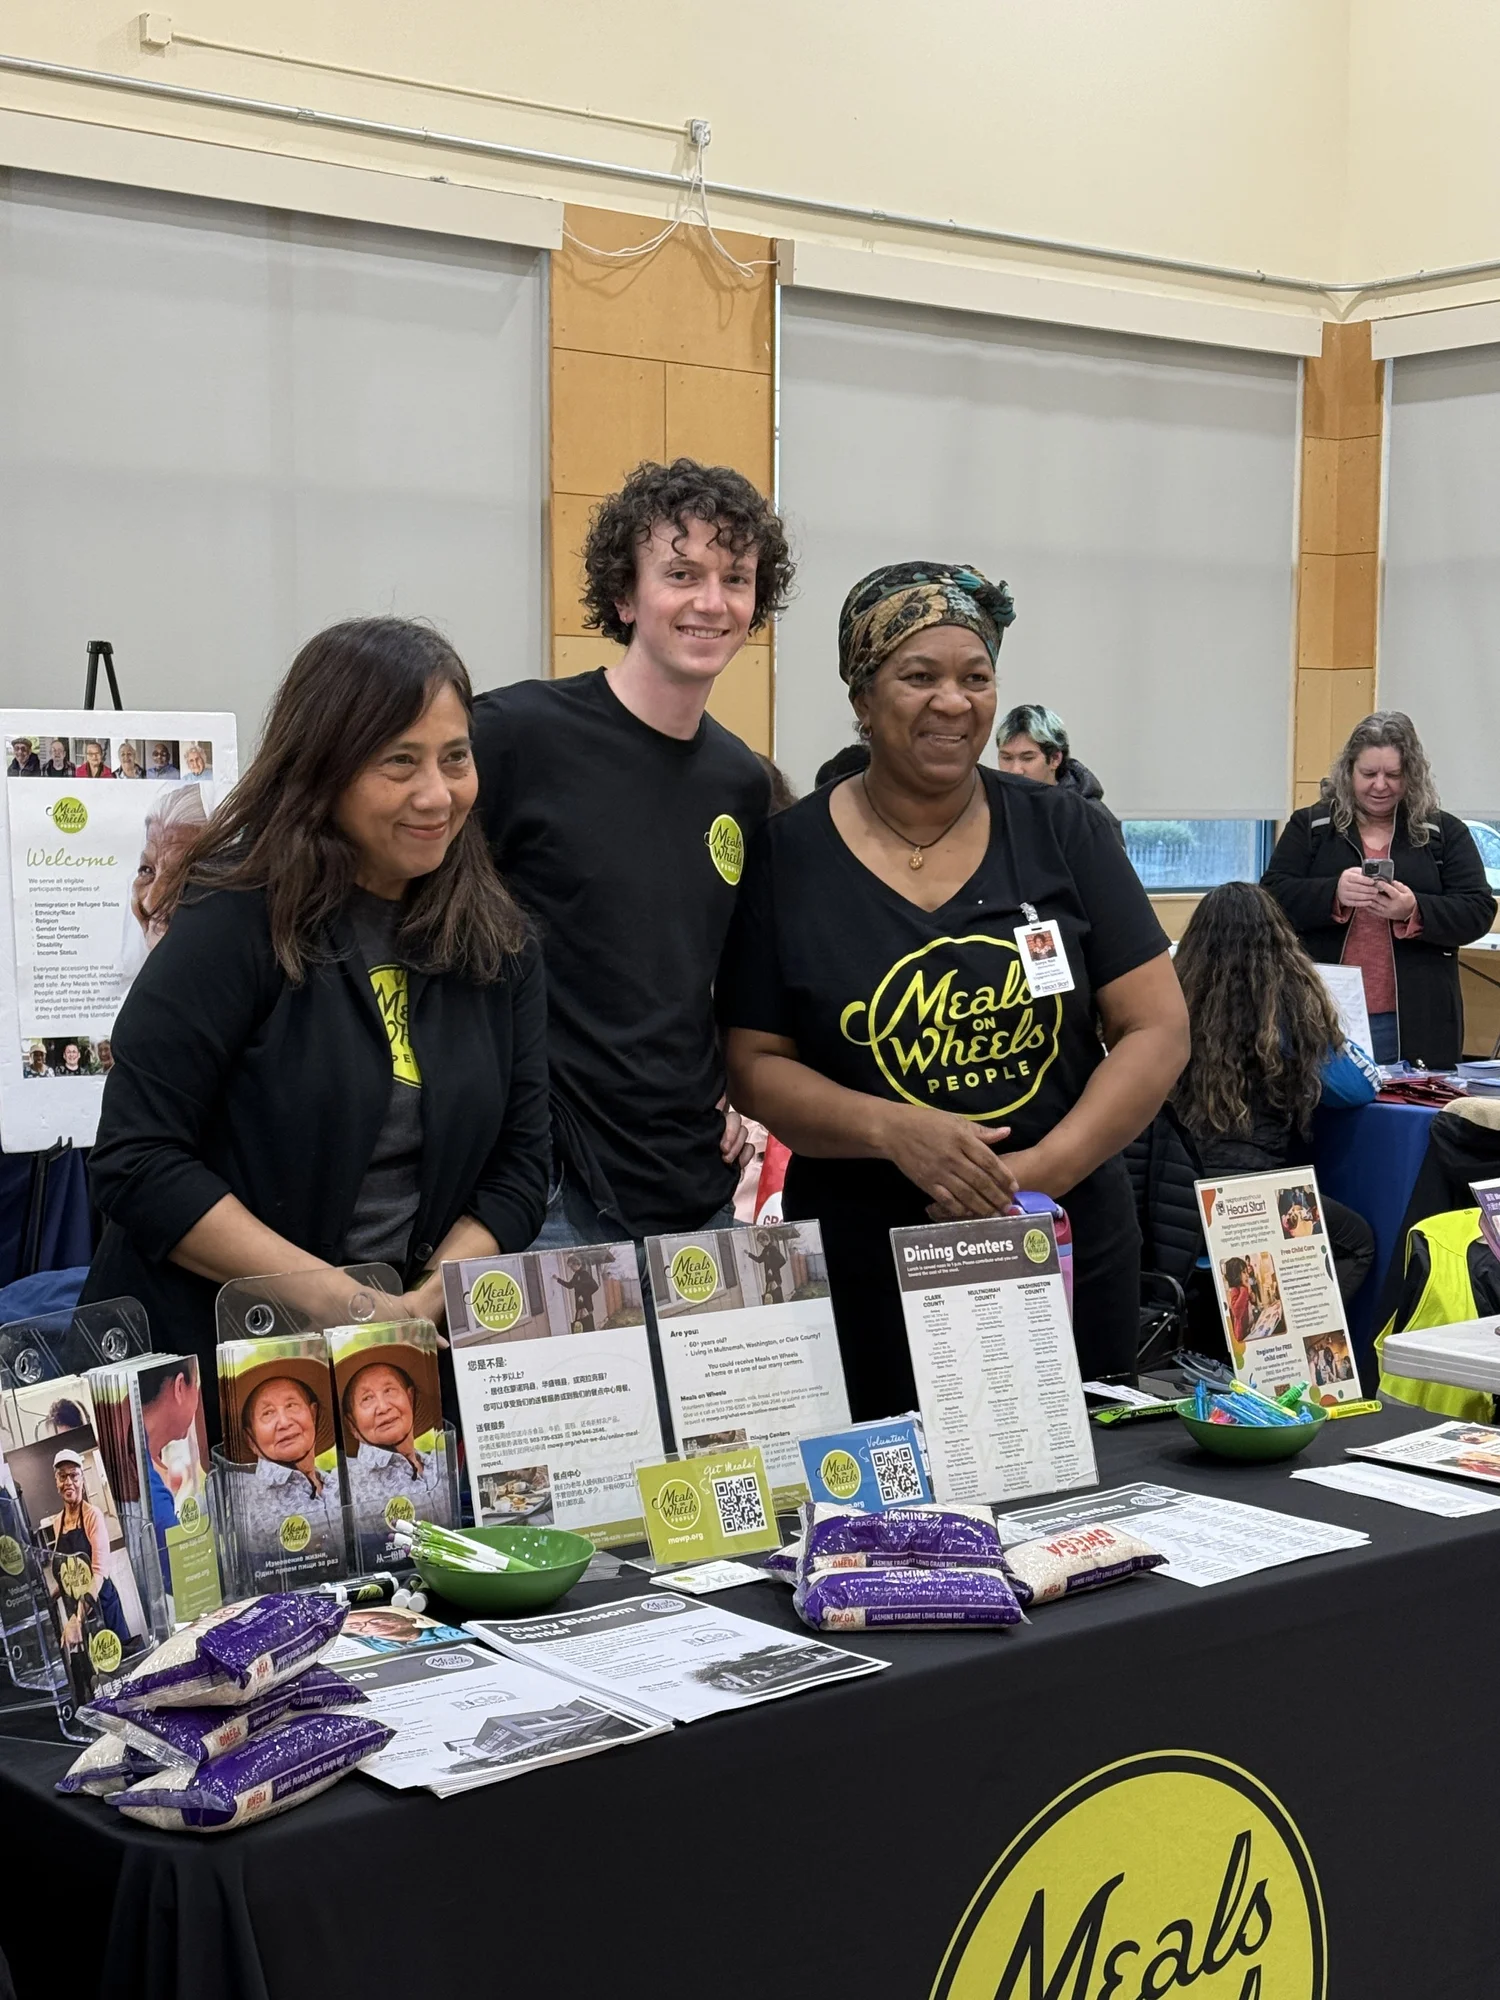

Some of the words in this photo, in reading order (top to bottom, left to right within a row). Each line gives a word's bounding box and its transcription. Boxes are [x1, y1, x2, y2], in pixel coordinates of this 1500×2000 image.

[46, 802, 84, 816] Meals
[27, 848, 117, 867] Welcome
[973, 1017, 995, 1031] ON
[888, 1007, 1044, 1075] Wheels
[928, 1060, 1030, 1093] PEOPLE
[1226, 1202, 1248, 1215] Head
[1248, 1199, 1266, 1212] Start
[903, 1244, 954, 1263] Dining
[956, 1239, 1013, 1258] Centers
[664, 1256, 710, 1278] Meals
[675, 1270, 713, 1287] Wheels
[1016, 1281, 1050, 1289] WASHINGTON
[463, 1281, 515, 1305] Meals
[684, 1286, 710, 1294] PEOPLE
[967, 1286, 1000, 1295] MULTNOMAH
[974, 1293, 995, 1301] COUNTY
[1024, 1287, 1045, 1295] COUNTY
[476, 1299, 518, 1316] Wheels
[922, 1299, 944, 1307] COUNTY
[485, 1313, 514, 1322] PEOPLE
[670, 1329, 682, 1337] Are
[683, 1328, 699, 1337] you:
[690, 1349, 706, 1357] Living
[713, 1344, 745, 1352] Multnomah,
[745, 1339, 778, 1348] Washington,
[785, 1335, 798, 1343] Clark
[800, 1332, 820, 1341] County?
[1256, 1347, 1274, 1356] Register
[1282, 1342, 1292, 1350] FREE
[778, 1351, 798, 1359] Wheels
[783, 1358, 804, 1366] centers.
[1264, 1354, 1275, 1362] child
[467, 1355, 507, 1371] 您是不是:
[706, 1389, 726, 1398] Wheels
[769, 1430, 790, 1438] Centers
[867, 1429, 910, 1447] Volunteer!
[480, 1460, 503, 1468] request.
[704, 1464, 724, 1480] Get
[724, 1456, 757, 1472] Meals!
[815, 1457, 854, 1480] Meals
[826, 1470, 858, 1487] Wheels
[652, 1487, 694, 1510] Meals
[663, 1500, 697, 1518] Wheels
[882, 1510, 933, 1521] JASMINE
[668, 1532, 704, 1544] mowp.org
[326, 1559, 338, 1569] раз
[832, 1559, 858, 1568] OMEGA
[945, 1560, 957, 1568] RICE
[498, 1621, 560, 1635] Cherry
[562, 1605, 636, 1627] Blossom
[871, 1613, 894, 1621] JASMINE
[922, 1612, 936, 1620] LONG
[936, 1612, 952, 1620] GRAIN
[509, 1627, 571, 1641] Center
